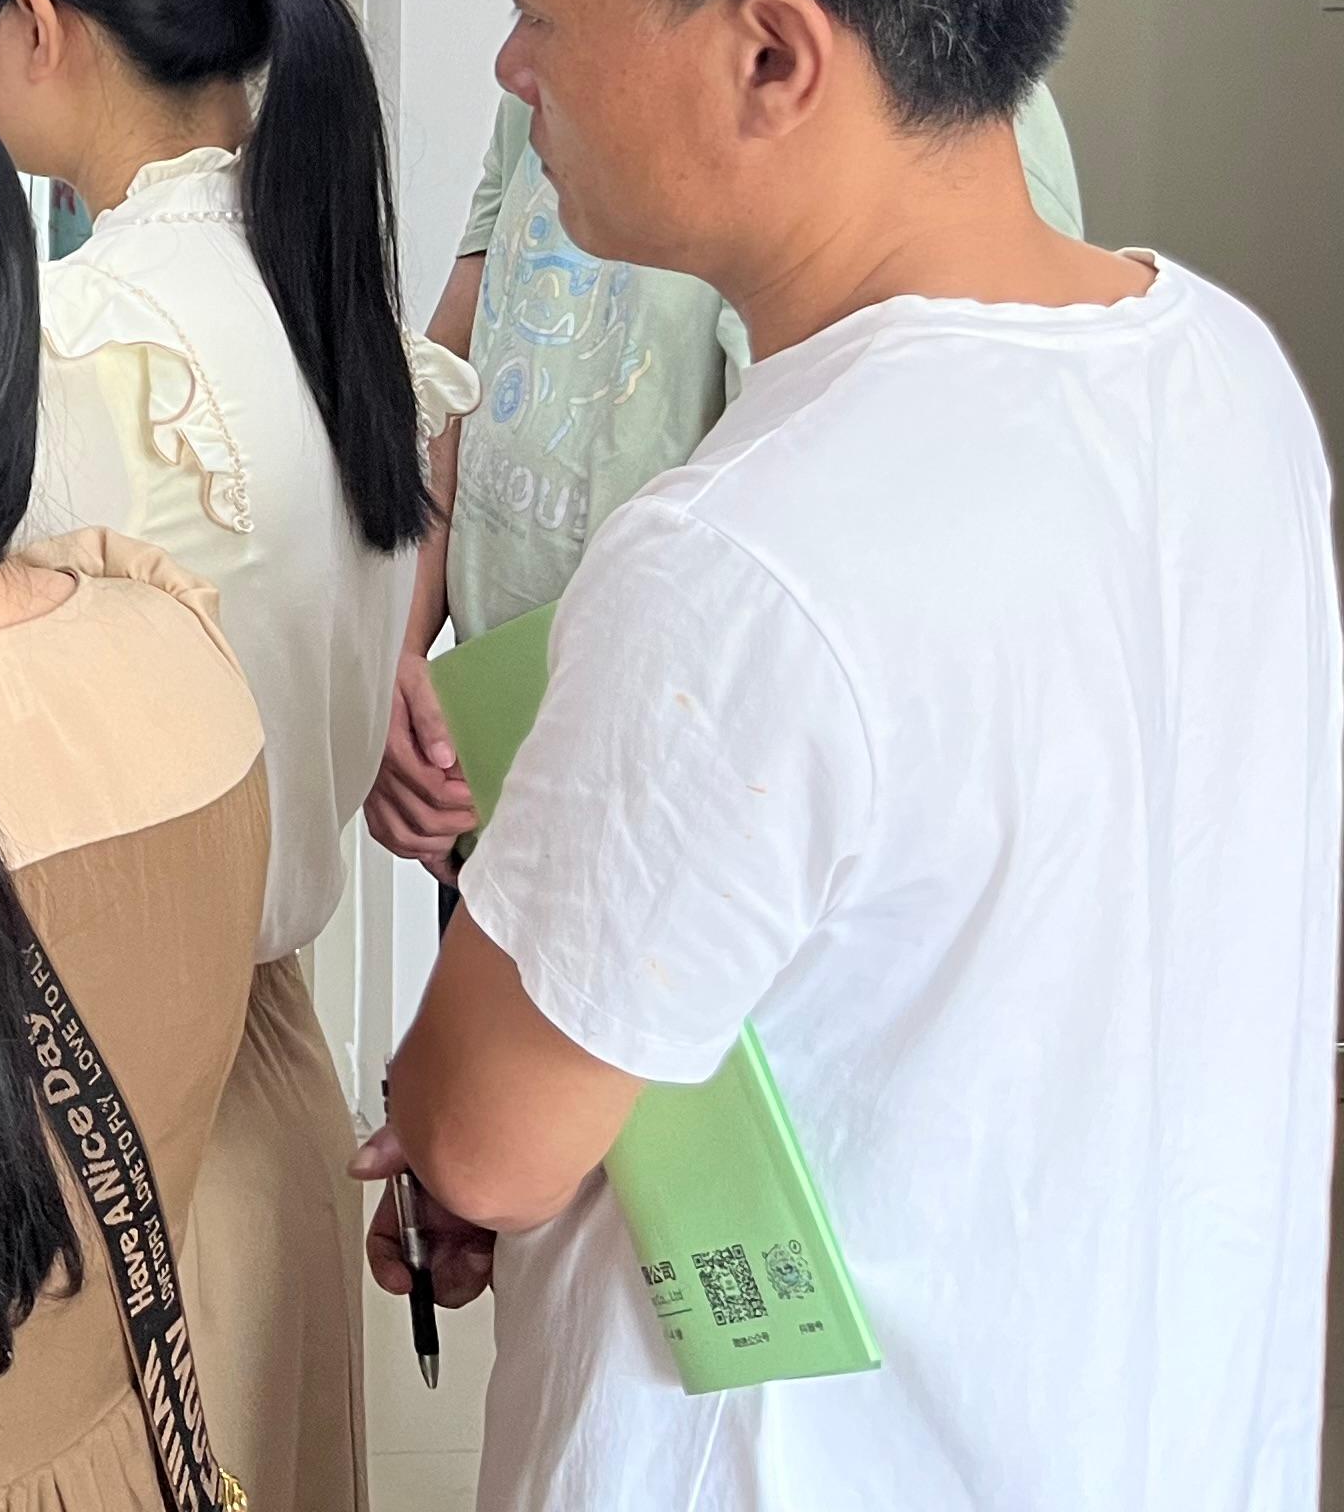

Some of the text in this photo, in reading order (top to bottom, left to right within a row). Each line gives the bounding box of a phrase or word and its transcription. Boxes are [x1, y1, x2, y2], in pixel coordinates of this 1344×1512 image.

[21, 943, 102, 1086] LOVE TO FLY
[22, 1013, 80, 1105] Day
[96, 1093, 153, 1212] LOVE TO FLY
[119, 1227, 155, 1318] Have
[157, 1263, 175, 1311] LOVE
